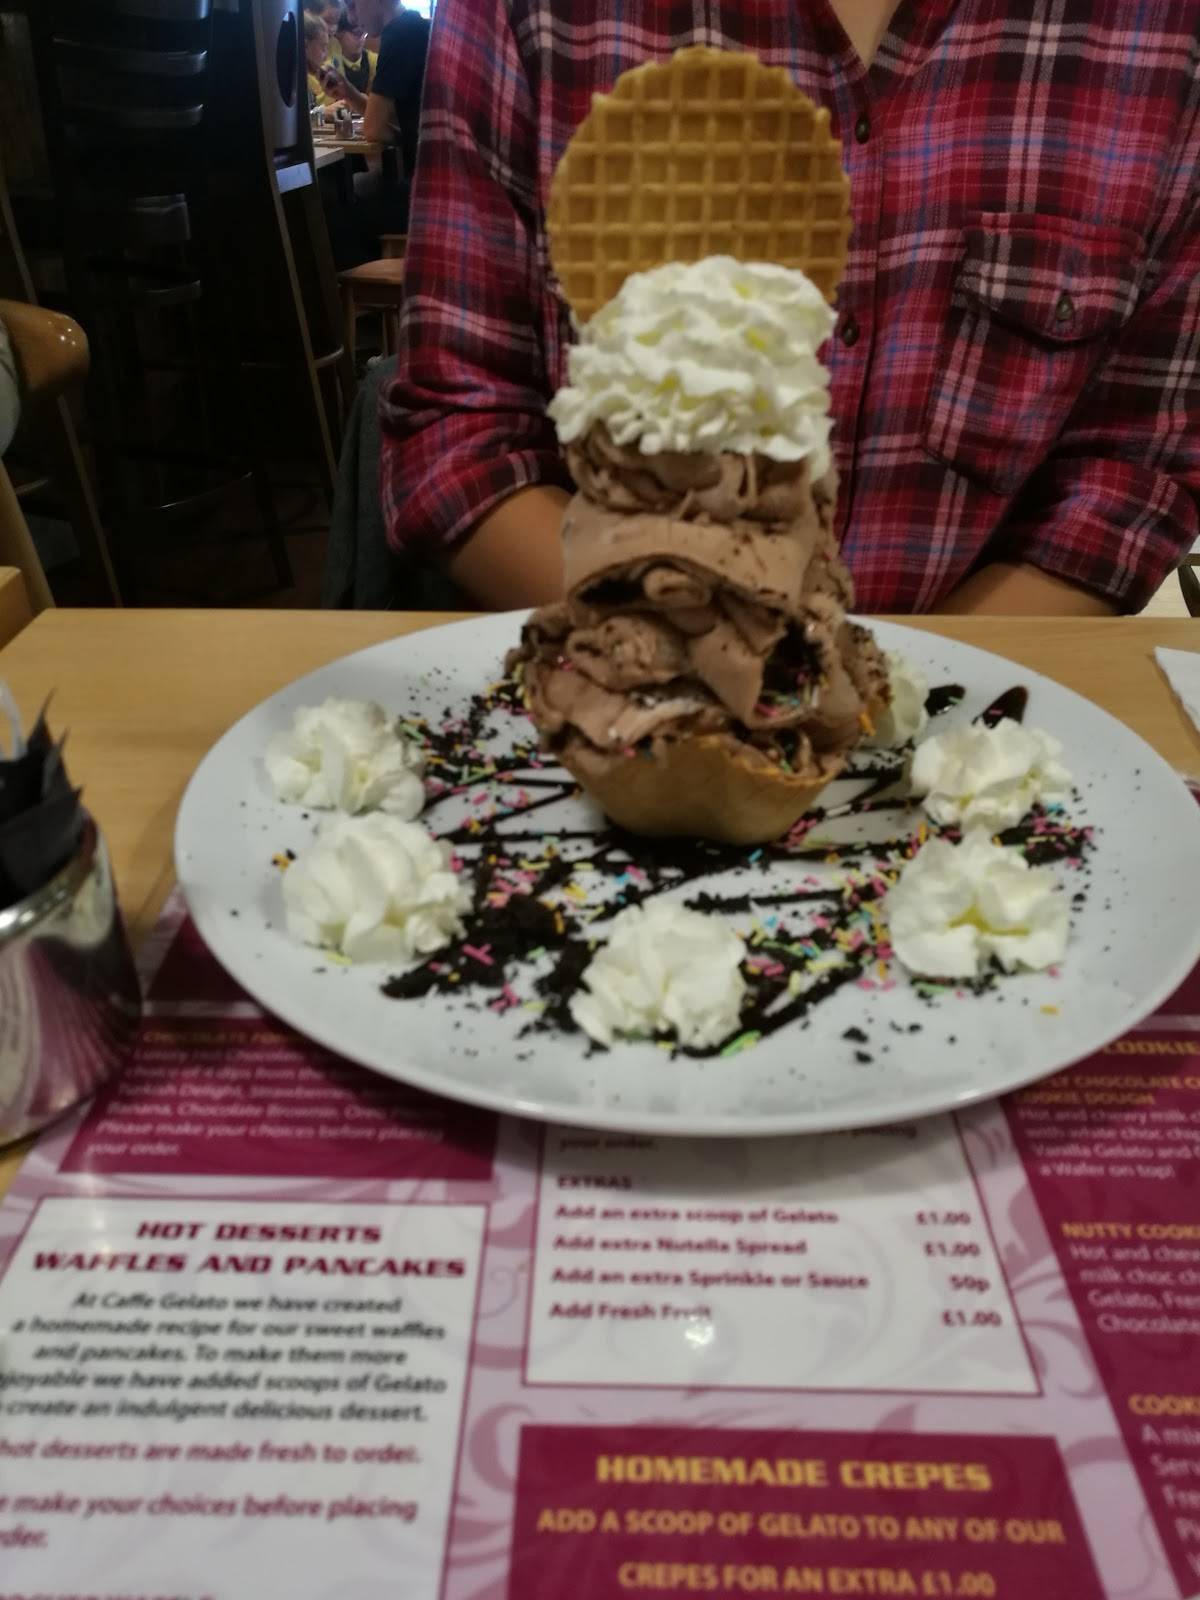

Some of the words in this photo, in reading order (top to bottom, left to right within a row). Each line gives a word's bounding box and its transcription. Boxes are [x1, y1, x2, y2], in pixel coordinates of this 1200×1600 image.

[155, 1121, 204, 1136] make
[205, 1123, 247, 1139] your
[557, 1175, 633, 1189] EXTRAS
[555, 1204, 596, 1219] Add
[601, 1208, 625, 1220] an
[630, 1206, 680, 1220] extra
[686, 1208, 742, 1224] scoop
[748, 1208, 768, 1221] of
[772, 1208, 839, 1223] Gelato
[916, 1211, 971, 1226] £1.00
[136, 1222, 206, 1240] HOT
[215, 1224, 383, 1244] DESSERTS
[1061, 1222, 1132, 1239] NUTTY
[553, 1236, 595, 1251] Add
[601, 1238, 652, 1252] extra
[656, 1238, 730, 1253] Nutella
[736, 1240, 807, 1257] Spread
[923, 1242, 981, 1257] £1.00
[1070, 1243, 1108, 1260] Hot
[1111, 1244, 1150, 1261] and
[33, 1252, 187, 1273] WAFFLES
[198, 1255, 272, 1274] AND
[284, 1256, 466, 1278] PANCAKES
[552, 1267, 595, 1283] Add
[600, 1272, 624, 1284] an
[630, 1271, 683, 1285] extra
[689, 1270, 774, 1288] Sprinkle
[780, 1276, 802, 1287] or
[807, 1271, 869, 1289] Sauce
[949, 1274, 990, 1293] 50p
[159, 1294, 228, 1311] Gelato
[233, 1298, 263, 1311] we
[267, 1295, 318, 1313] have
[322, 1297, 403, 1313] created
[551, 1302, 594, 1319] Add
[598, 1302, 656, 1320] Fresh
[29, 1316, 153, 1335] homemade
[155, 1320, 222, 1339] recipe
[226, 1318, 257, 1336] for
[261, 1323, 301, 1338] our
[304, 1323, 366, 1338] sweet
[941, 1310, 1002, 1327] £1.00
[33, 1344, 79, 1361] and
[195, 1343, 220, 1361] To
[221, 1345, 282, 1363] make
[287, 1345, 346, 1364] them
[349, 1349, 407, 1365] more
[92, 1373, 125, 1389] we
[128, 1370, 184, 1390] have
[187, 1371, 260, 1391] added
[263, 1376, 340, 1395] scoops
[344, 1374, 369, 1392] of
[372, 1372, 447, 1393] Gelato
[81, 1403, 113, 1418] an
[115, 1400, 228, 1423] indulgent
[231, 1401, 333, 1420] delicious
[40, 1438, 139, 1460] desserts
[143, 1445, 181, 1461] are
[185, 1442, 252, 1462] made
[257, 1441, 317, 1463] fresh
[321, 1446, 348, 1463] to
[595, 1455, 828, 1488] HOMEMADE
[839, 1459, 993, 1493] CREPES
[12, 1491, 82, 1515] make
[82, 1498, 143, 1521] your
[146, 1492, 238, 1516] choices
[242, 1495, 322, 1517] before
[326, 1497, 419, 1523] placing
[537, 1508, 597, 1535] ADD
[601, 1509, 621, 1534] A
[624, 1509, 714, 1536] SCOOP
[718, 1511, 752, 1537] OF
[758, 1511, 861, 1540] GELATO
[863, 1514, 899, 1541] TO
[905, 1515, 960, 1542] ANY
[963, 1517, 999, 1543] OF
[1004, 1518, 1067, 1545] OUR
[617, 1561, 719, 1592] CREPES
[722, 1564, 778, 1593] FOR
[781, 1566, 824, 1594] AN
[827, 1566, 919, 1597] EXTRA
[921, 1569, 998, 1599] £1.00
